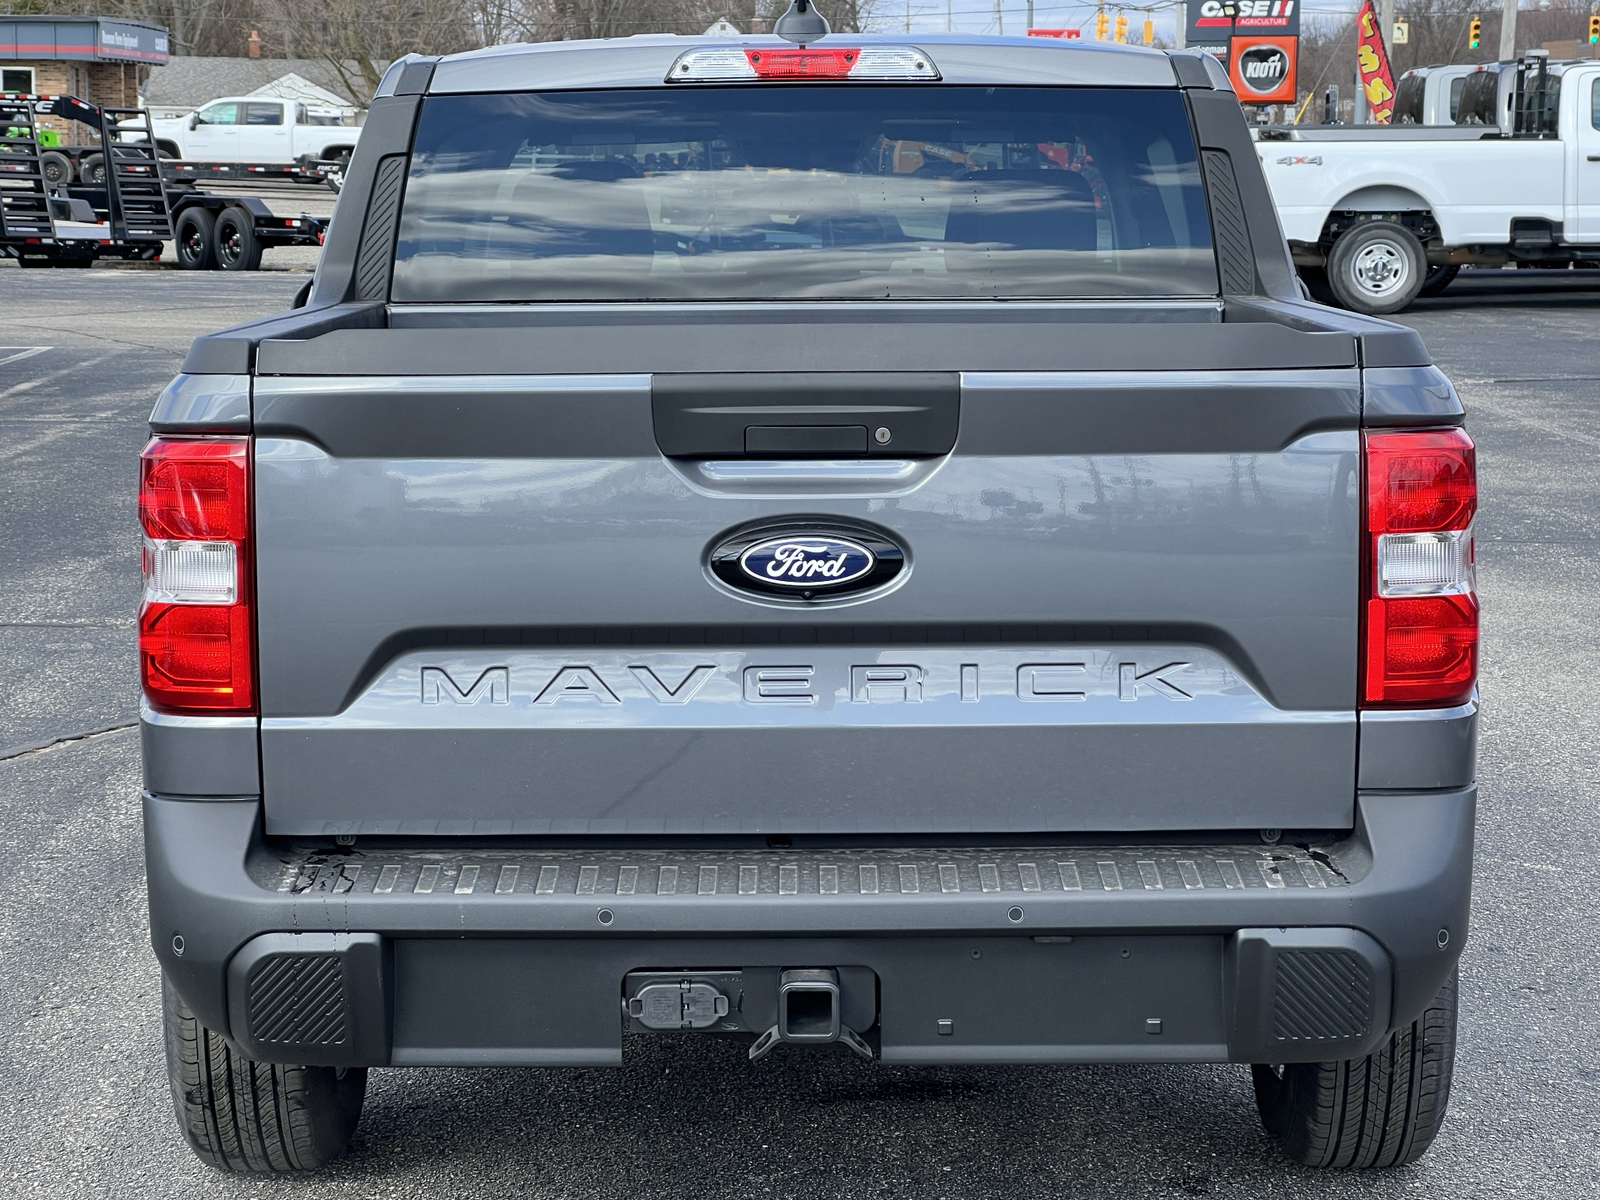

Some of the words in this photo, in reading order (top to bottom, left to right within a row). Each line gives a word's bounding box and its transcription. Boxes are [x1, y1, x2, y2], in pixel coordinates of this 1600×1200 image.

[1246, 61, 1282, 78] KIOTI
[766, 544, 848, 577] Ford
[421, 662, 1194, 703] MAVERICK
